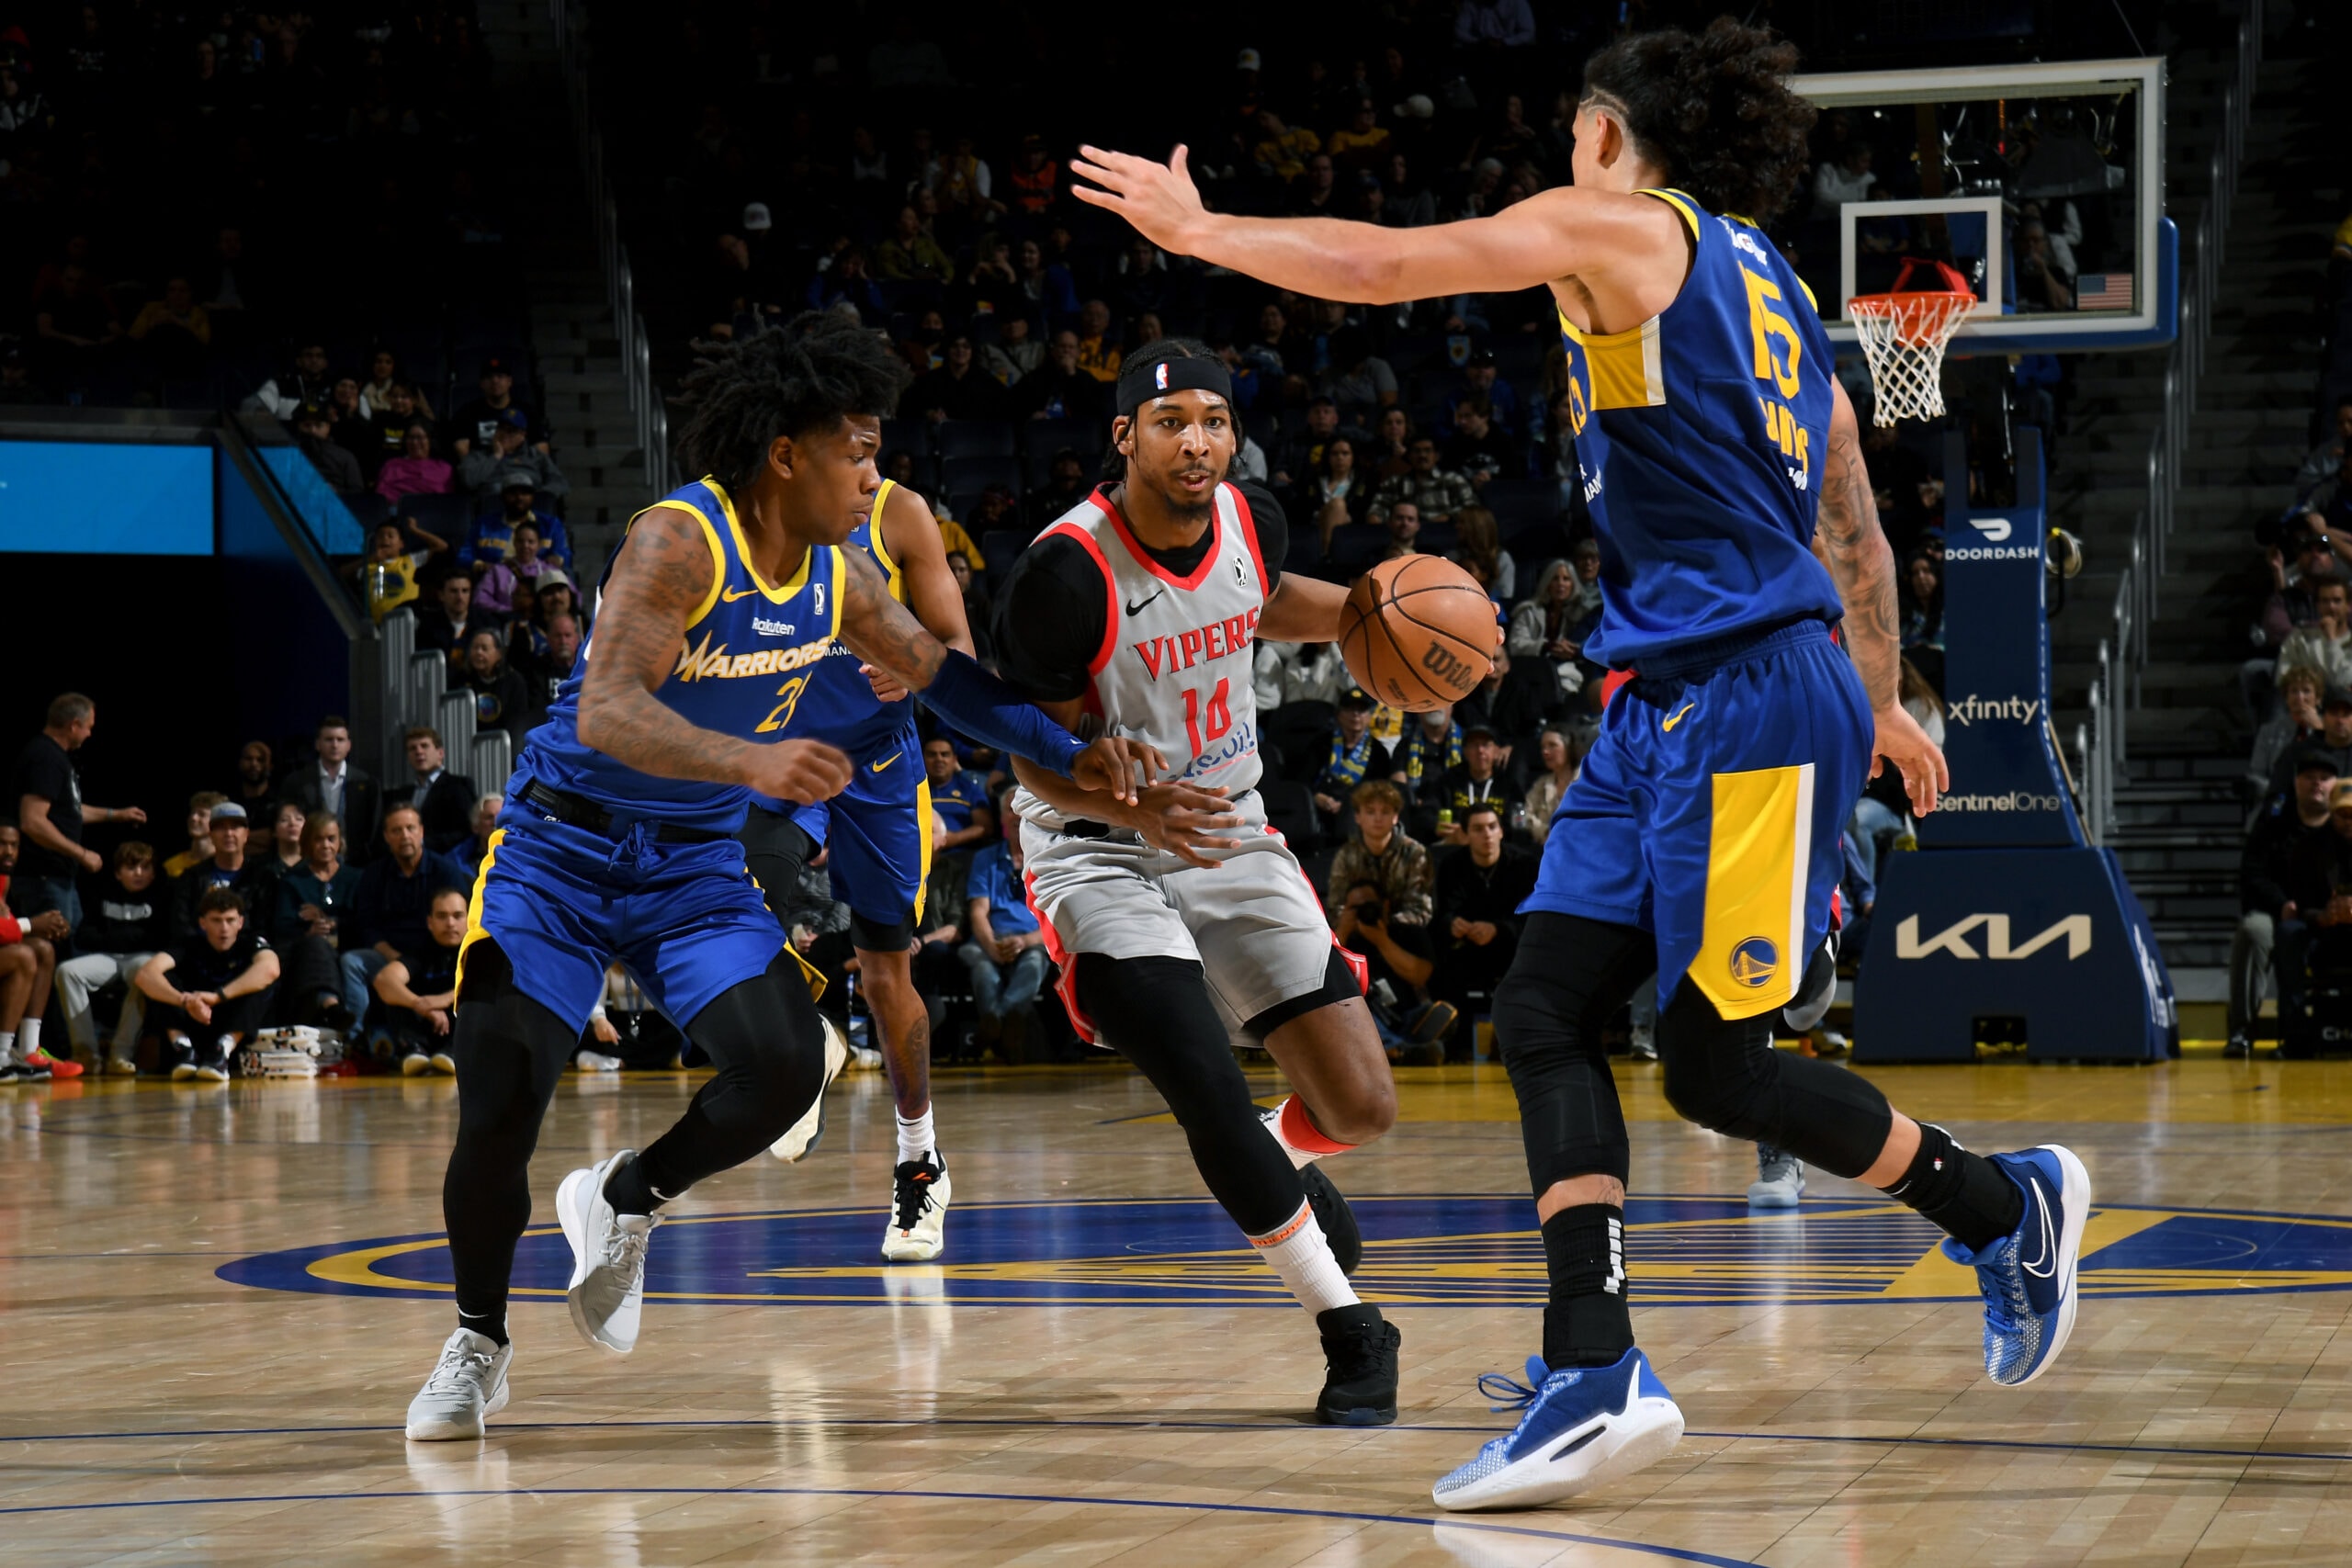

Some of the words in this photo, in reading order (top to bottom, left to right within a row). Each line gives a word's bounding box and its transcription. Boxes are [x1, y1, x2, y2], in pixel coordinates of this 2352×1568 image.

[1945, 546, 2039, 561] DOORDASH
[752, 617, 796, 637] Rakuten
[1133, 605, 1261, 682] VIPERS
[673, 630, 832, 682] WARRIORS
[1948, 694, 2039, 727] xfinity
[1935, 791, 2060, 812] SentinelOne
[1895, 913, 2092, 960] KIA
